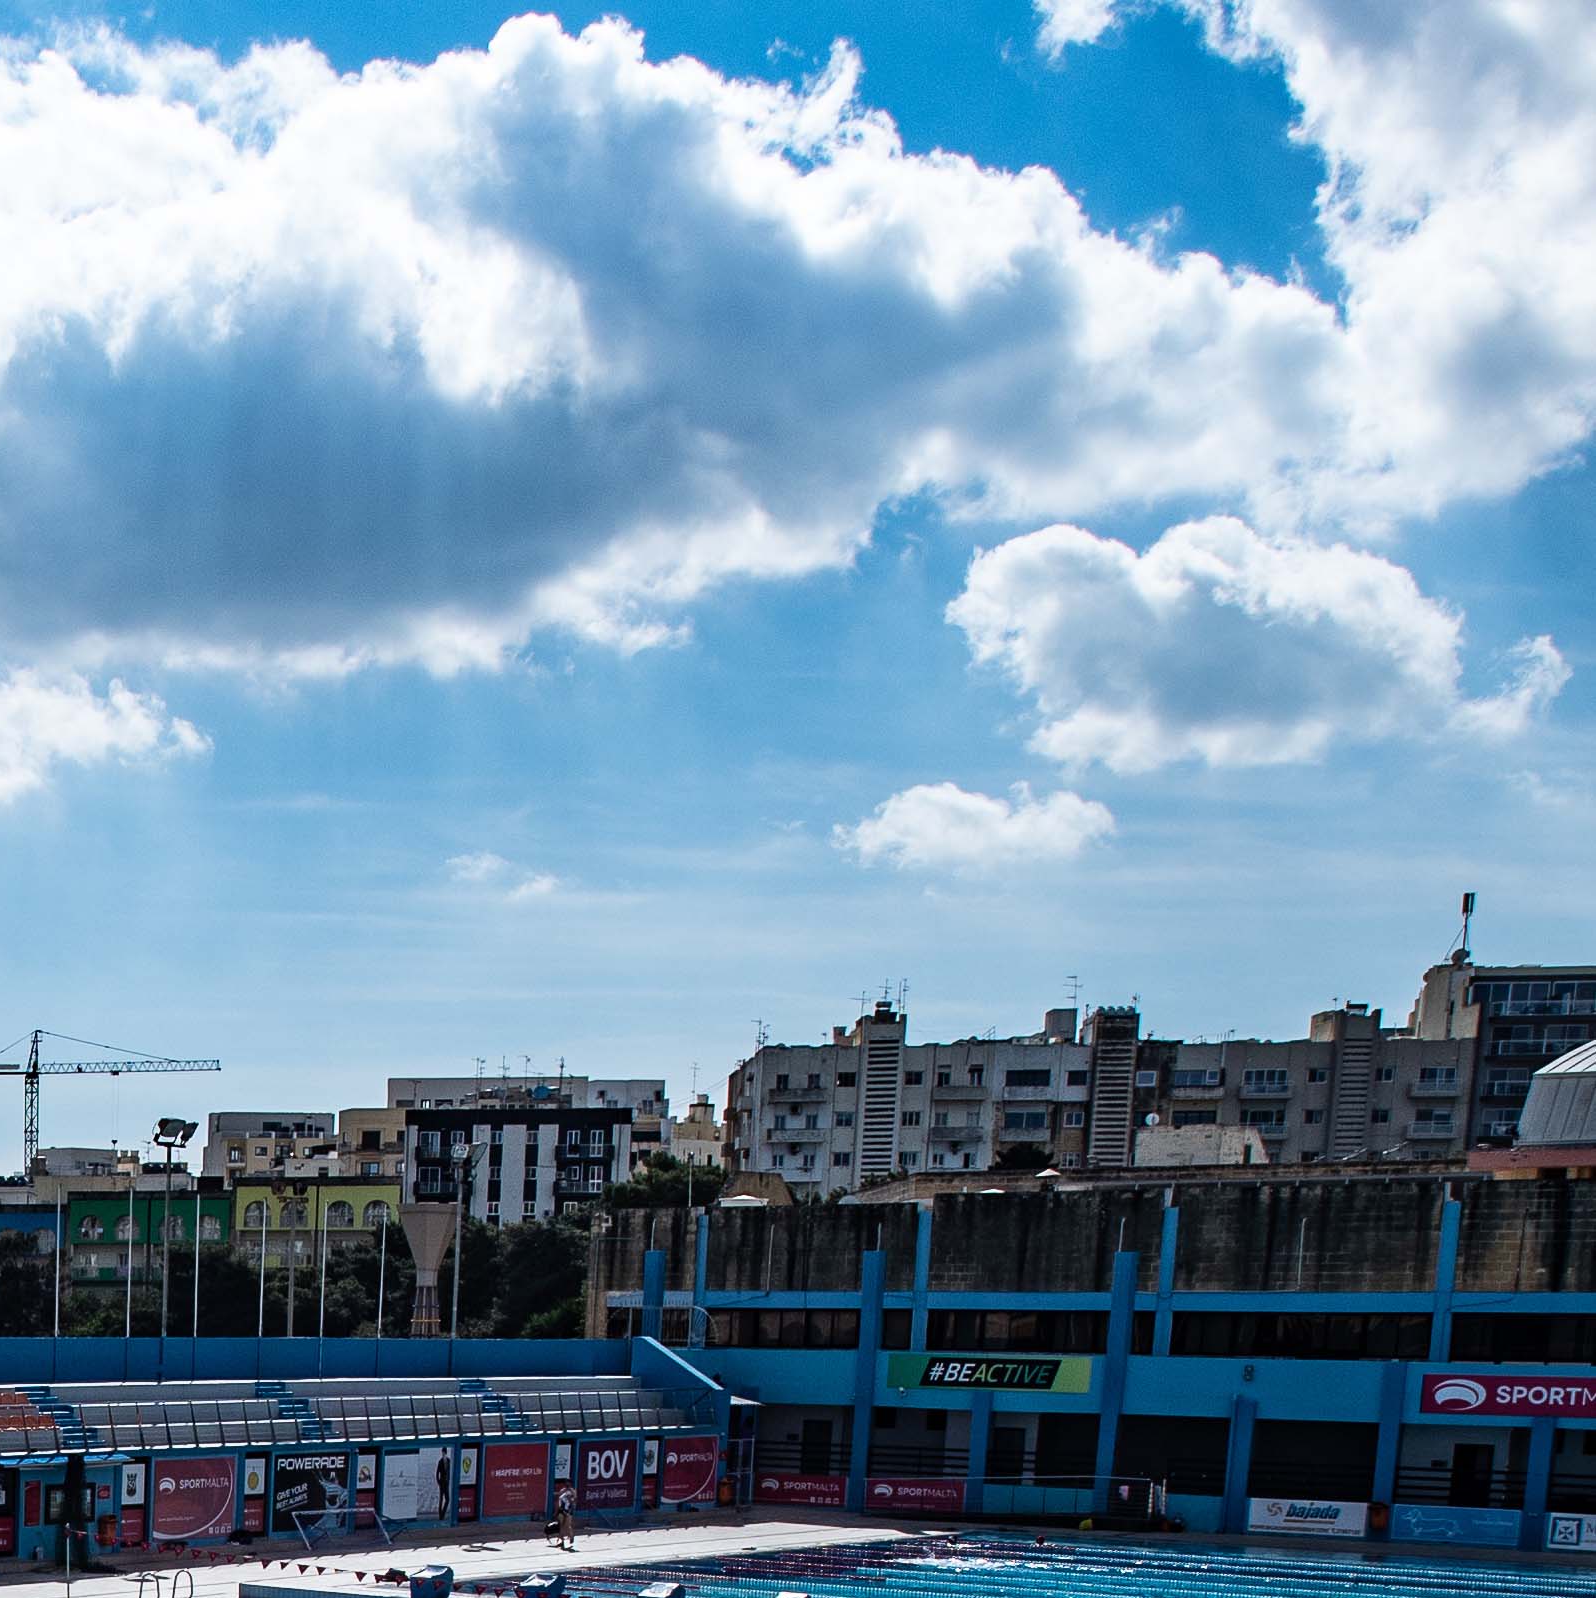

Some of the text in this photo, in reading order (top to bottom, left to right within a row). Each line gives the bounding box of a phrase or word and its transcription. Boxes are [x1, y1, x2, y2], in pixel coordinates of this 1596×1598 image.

[929, 1363, 1054, 1384] #BEACTIVE
[277, 1456, 346, 1471] POWERADE
[587, 1449, 629, 1480] BOV
[179, 1477, 229, 1489] SPORTMALTA
[783, 1481, 840, 1492] SPORTMALTA
[896, 1487, 957, 1497] SPORTMALTA
[1285, 1502, 1341, 1520] bajada
